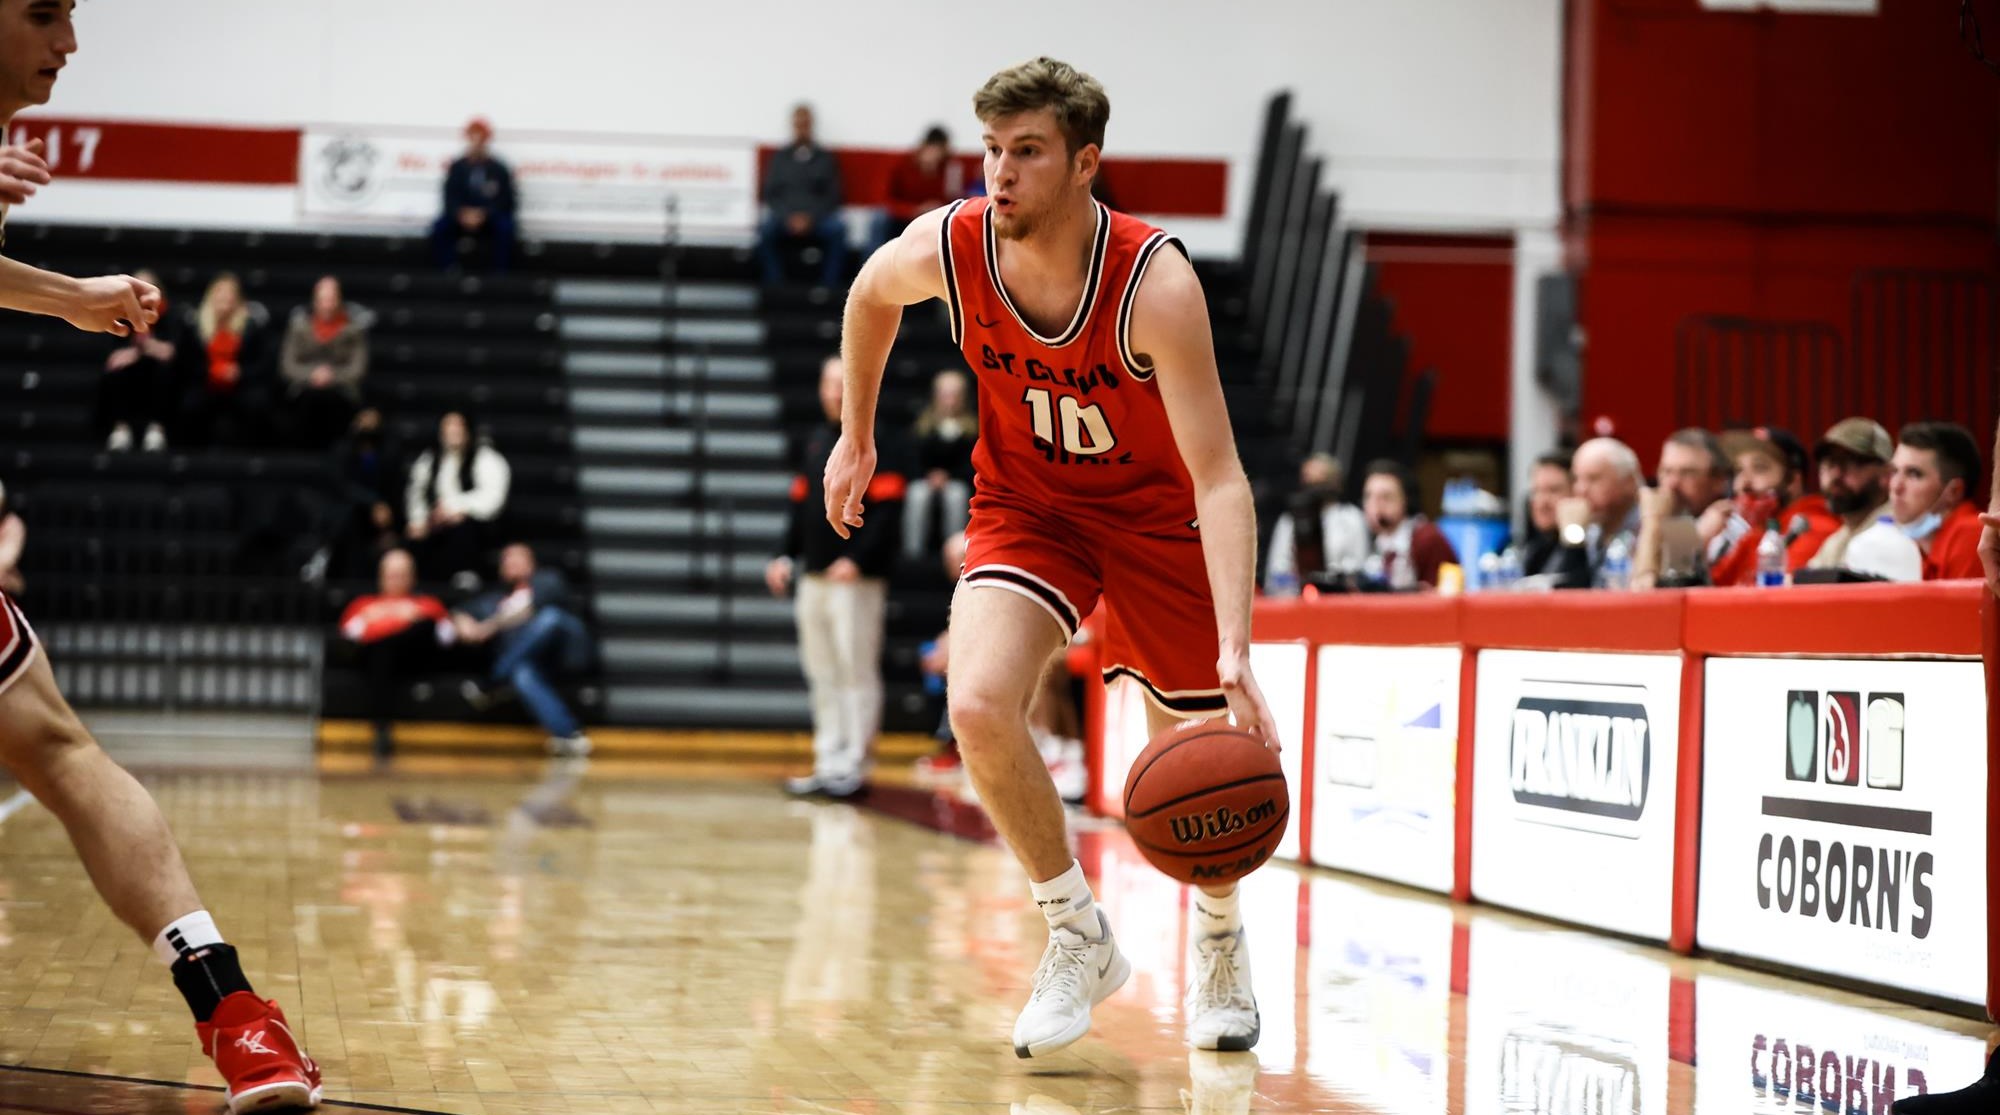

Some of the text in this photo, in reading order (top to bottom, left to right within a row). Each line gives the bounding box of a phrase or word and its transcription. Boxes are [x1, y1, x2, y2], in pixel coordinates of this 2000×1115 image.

[982, 344, 1022, 378] ST.
[1023, 386, 1118, 455] 10
[1509, 708, 1648, 807] FRANKLIN
[1169, 798, 1276, 844] Wilson
[1756, 832, 1934, 940] COBORN'S
